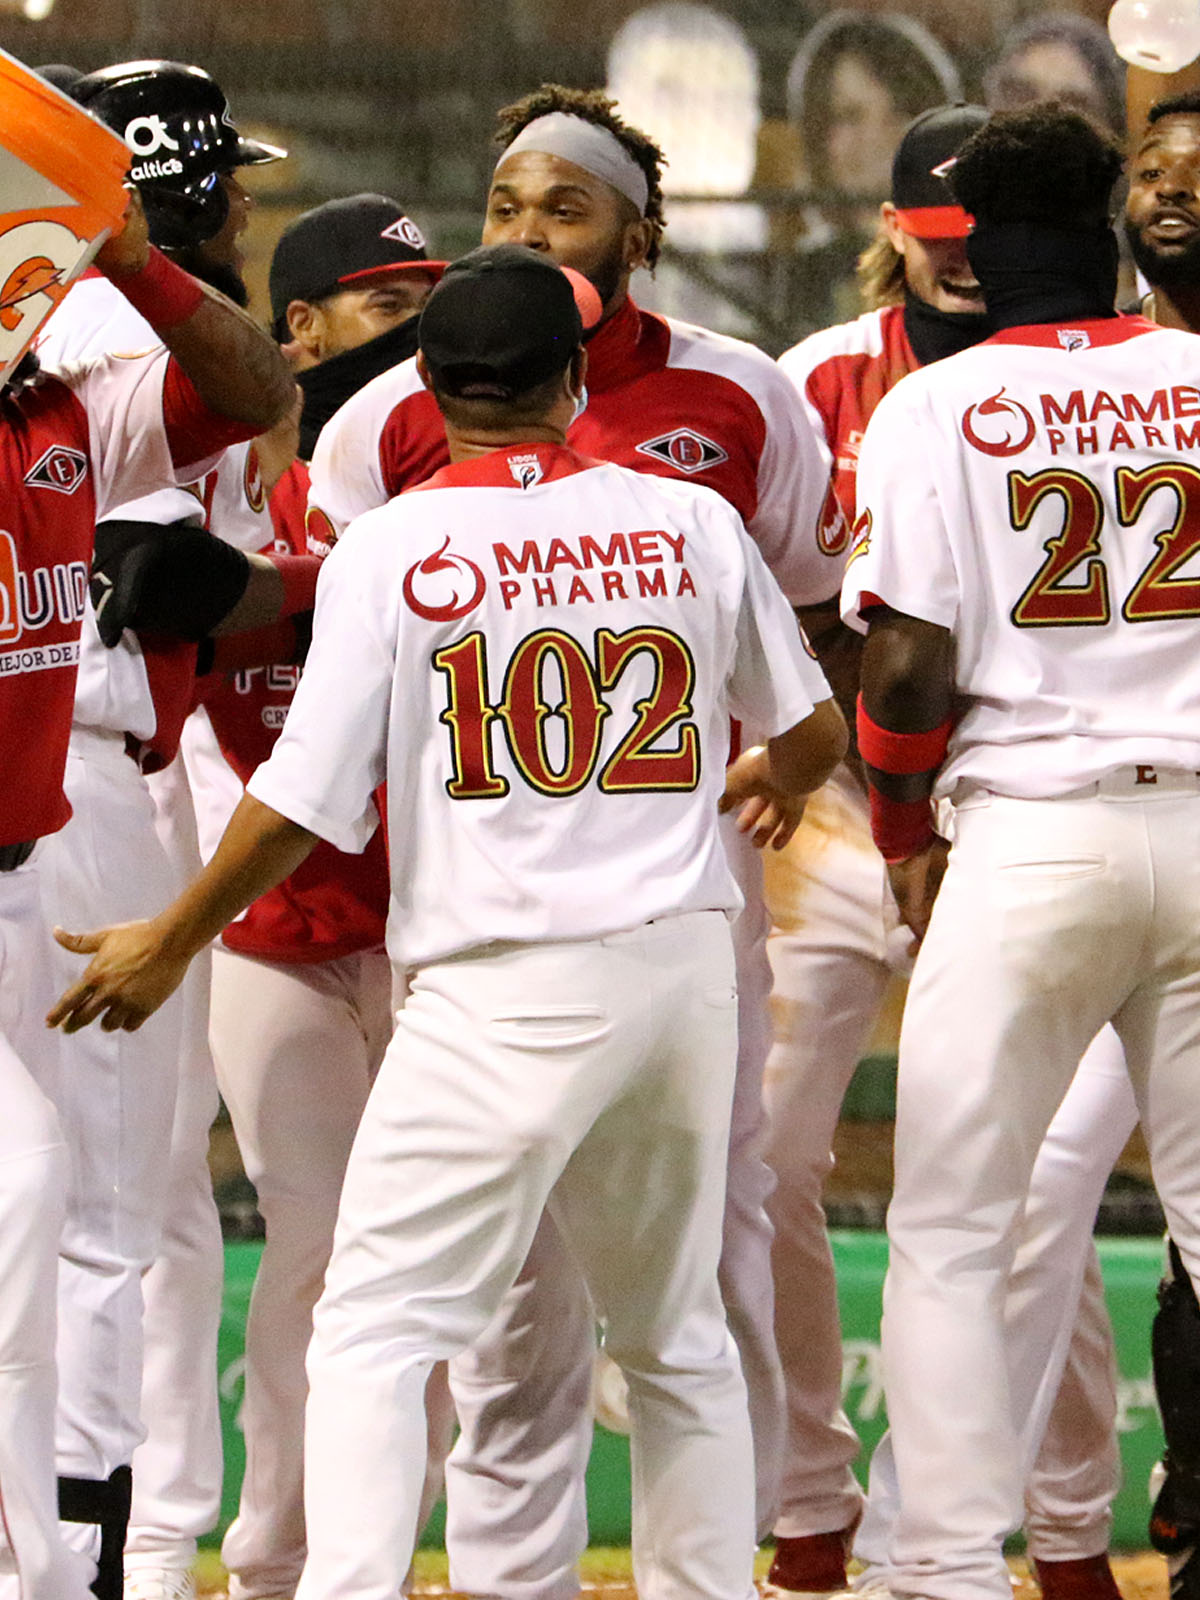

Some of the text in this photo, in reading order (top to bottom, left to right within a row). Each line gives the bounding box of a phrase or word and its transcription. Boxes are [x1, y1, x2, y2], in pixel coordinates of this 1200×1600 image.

[131, 158, 183, 182] altice
[492, 530, 685, 576] MAMEY
[499, 568, 698, 610] PHARMA
[49, 647, 72, 664] DE
[431, 624, 701, 800] 102
